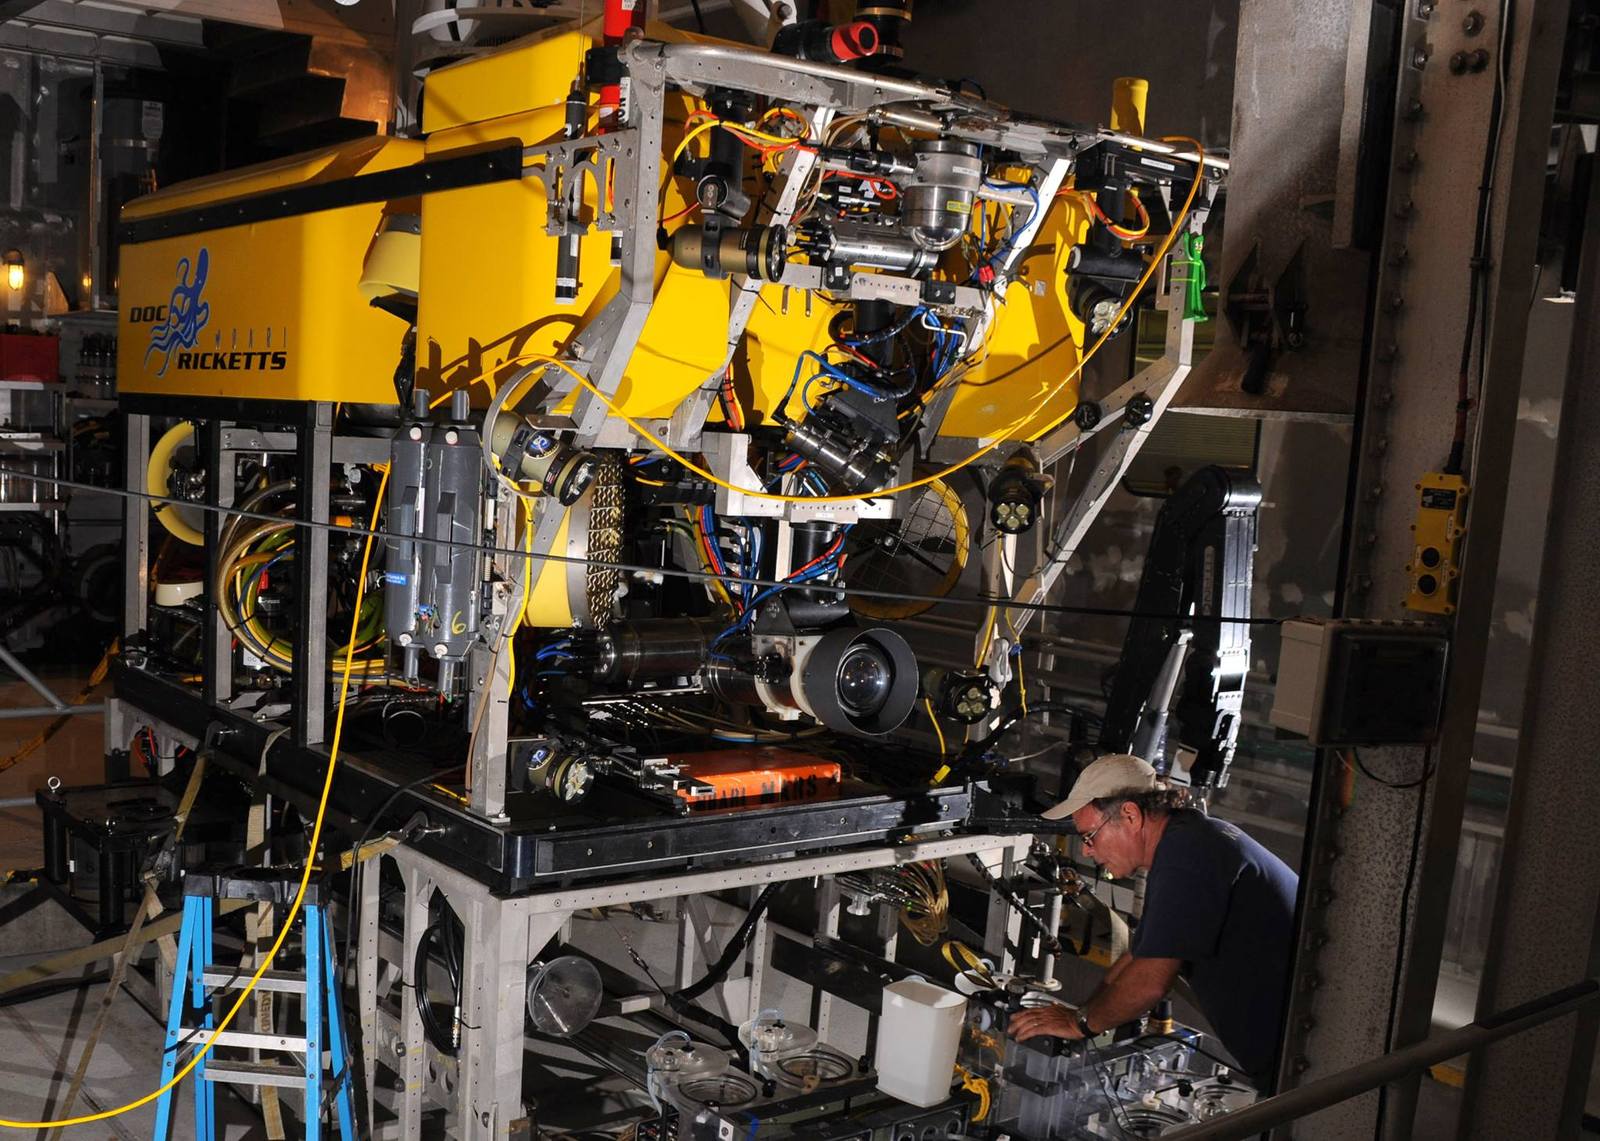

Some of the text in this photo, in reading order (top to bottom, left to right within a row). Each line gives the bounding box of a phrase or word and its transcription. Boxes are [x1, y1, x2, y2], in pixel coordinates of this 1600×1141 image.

[129, 304, 168, 323] DOC
[214, 326, 287, 350] MBARI
[177, 350, 287, 370] RICKETTS
[451, 610, 467, 635] 6
